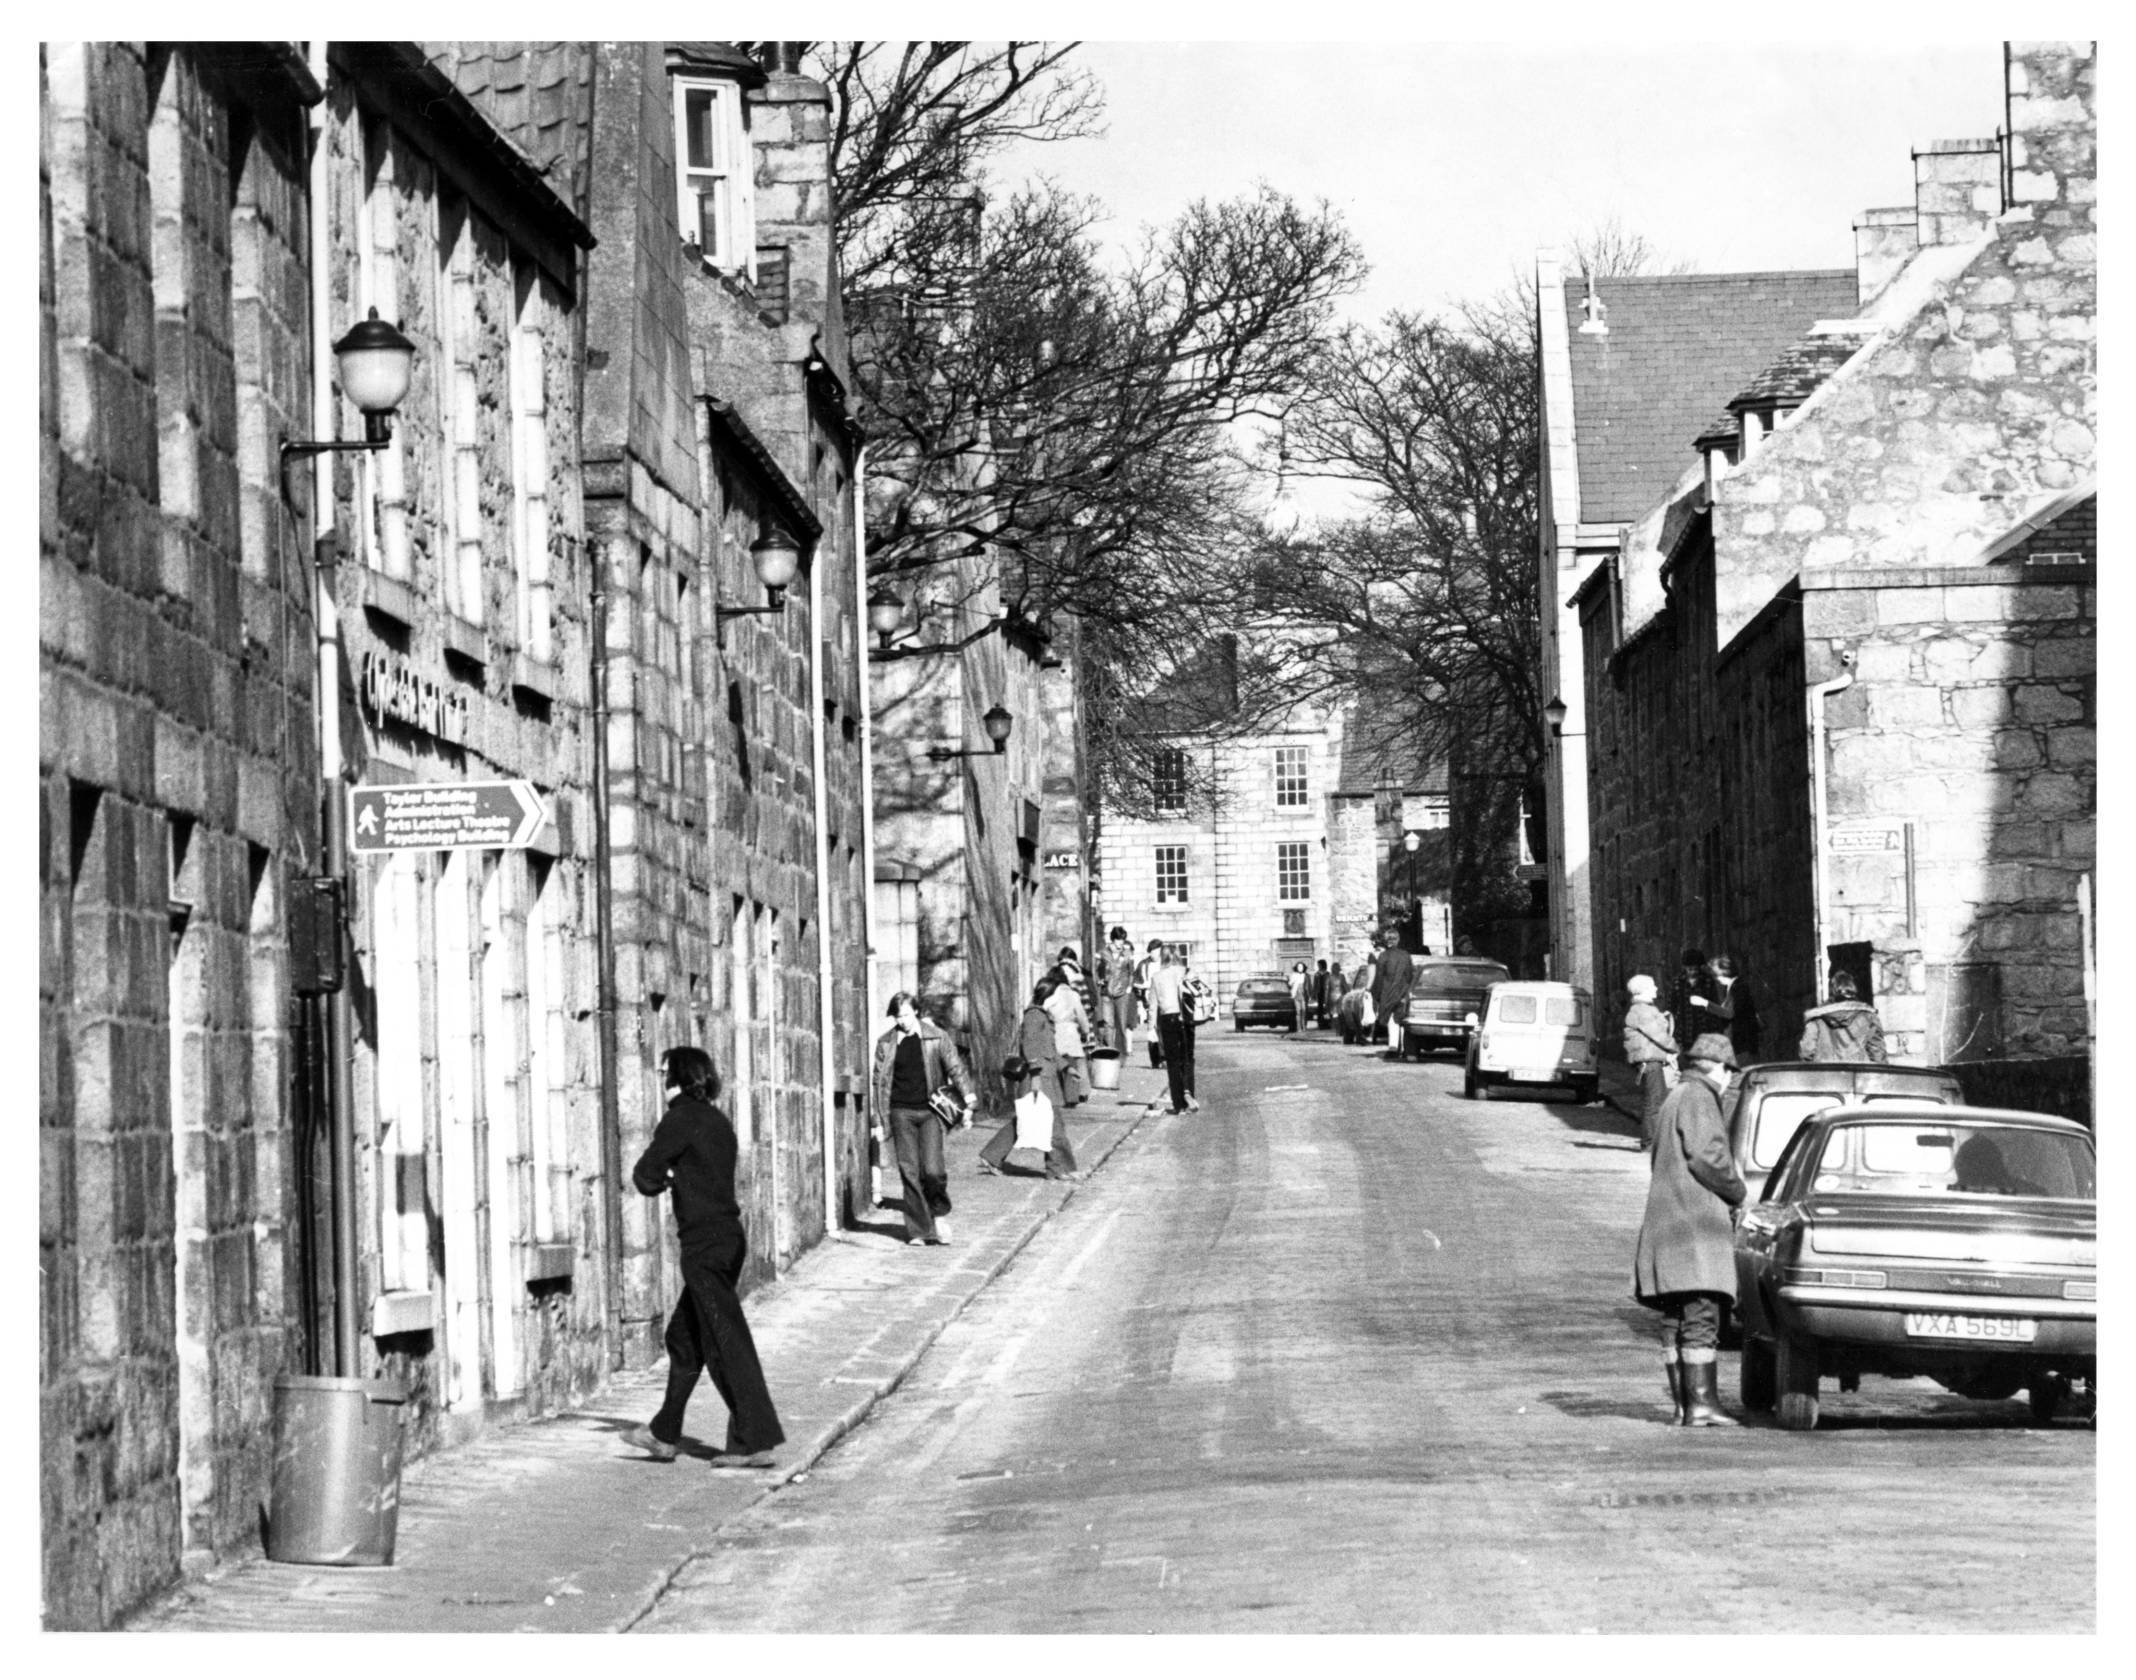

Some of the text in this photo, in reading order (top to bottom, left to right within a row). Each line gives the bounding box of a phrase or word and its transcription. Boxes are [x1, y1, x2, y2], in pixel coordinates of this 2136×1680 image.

[383, 790, 477, 807] Taylor Building
[384, 815, 511, 831] Arts Lecture Theatre
[384, 828, 510, 846] Psychology Building
[1912, 1313, 2029, 1339] VXA 569L
